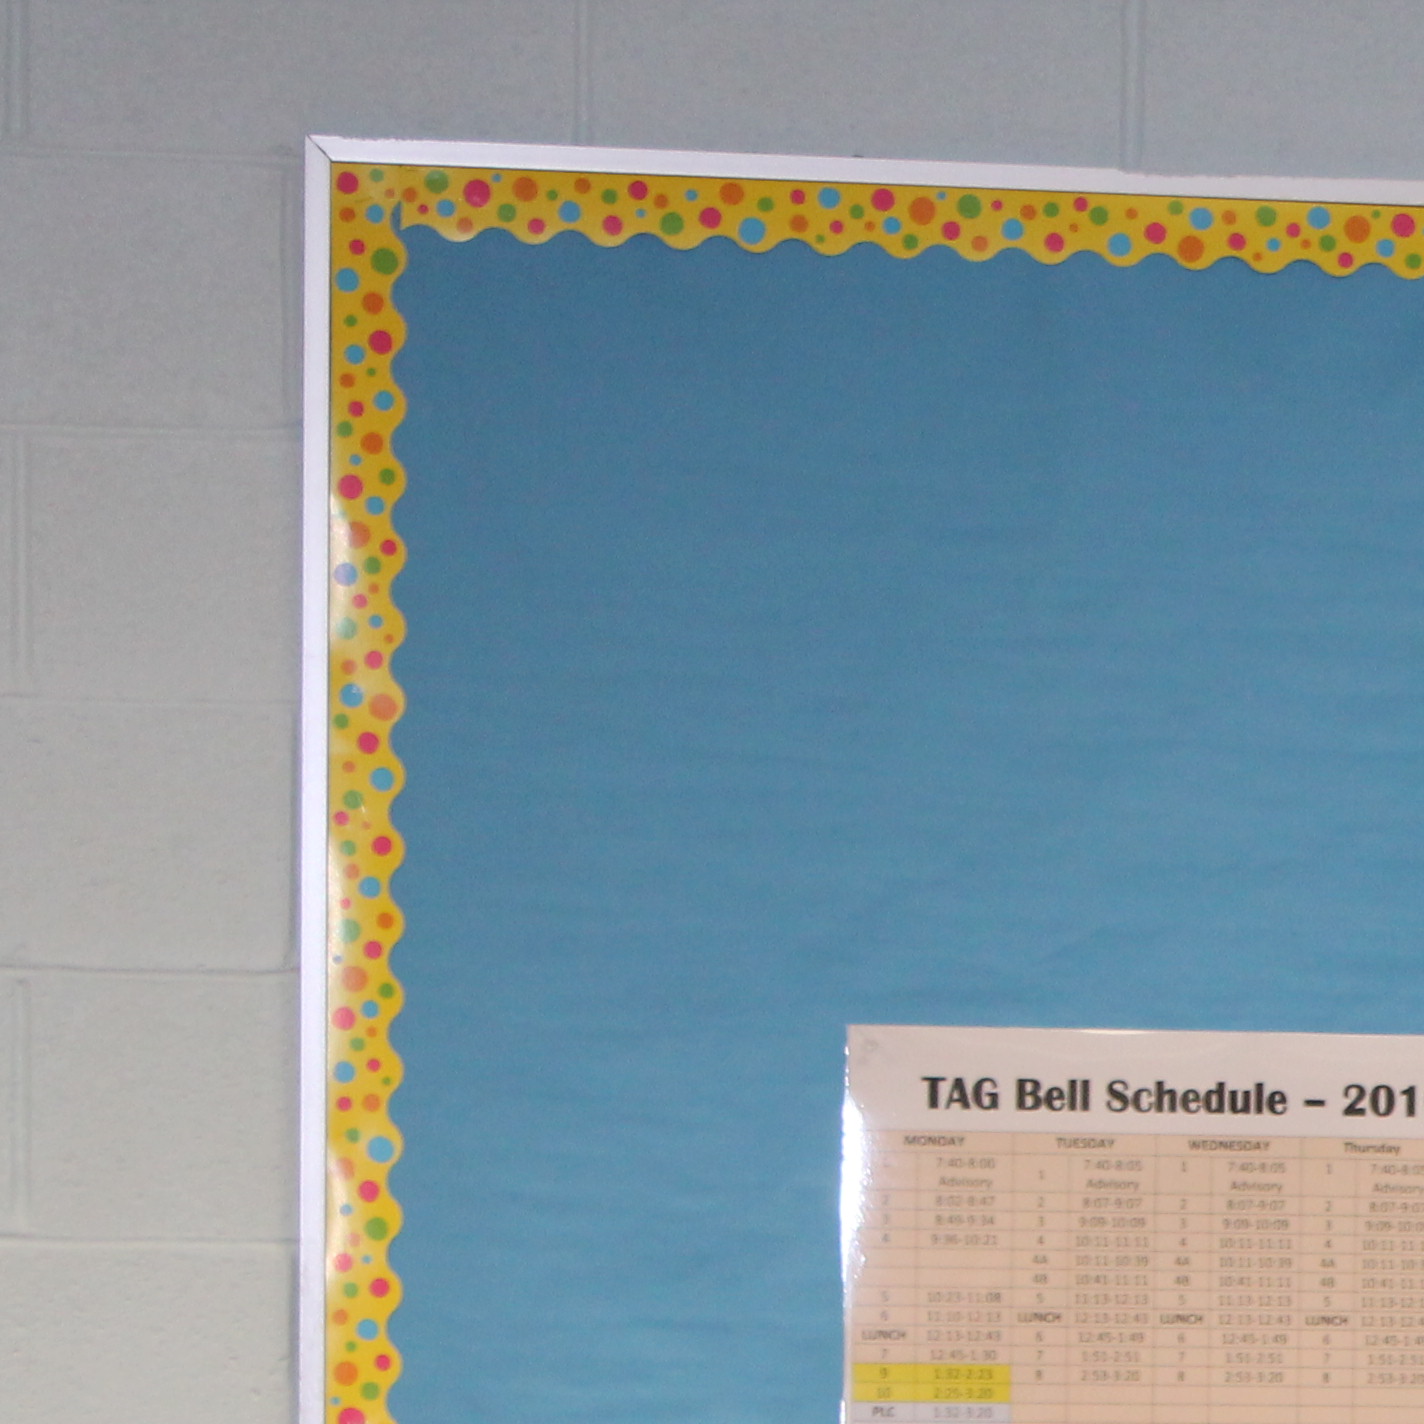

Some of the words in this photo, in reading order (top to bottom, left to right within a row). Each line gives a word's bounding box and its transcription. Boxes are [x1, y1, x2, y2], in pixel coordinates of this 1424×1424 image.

[921, 1076, 999, 1111] TAG
[1016, 1078, 1090, 1112] Bell
[1106, 1079, 1288, 1116] Schedule
[904, 1135, 966, 1147] MONDAY
[1056, 1137, 1116, 1149] TUESDAY
[1188, 1140, 1271, 1151] WEDNESDAY
[1343, 1142, 1401, 1156] Thursday
[939, 1176, 994, 1190] Advisory
[1086, 1178, 1140, 1192] Advisory
[1230, 1181, 1283, 1194] Advisory
[1372, 1183, 1424, 1196] Advisory
[1017, 1312, 1062, 1323] LUNCH
[1159, 1313, 1204, 1325] LUNCH
[1304, 1315, 1349, 1327] LUNCH
[861, 1329, 906, 1341] LUNCH
[872, 1406, 895, 1418] PLC
